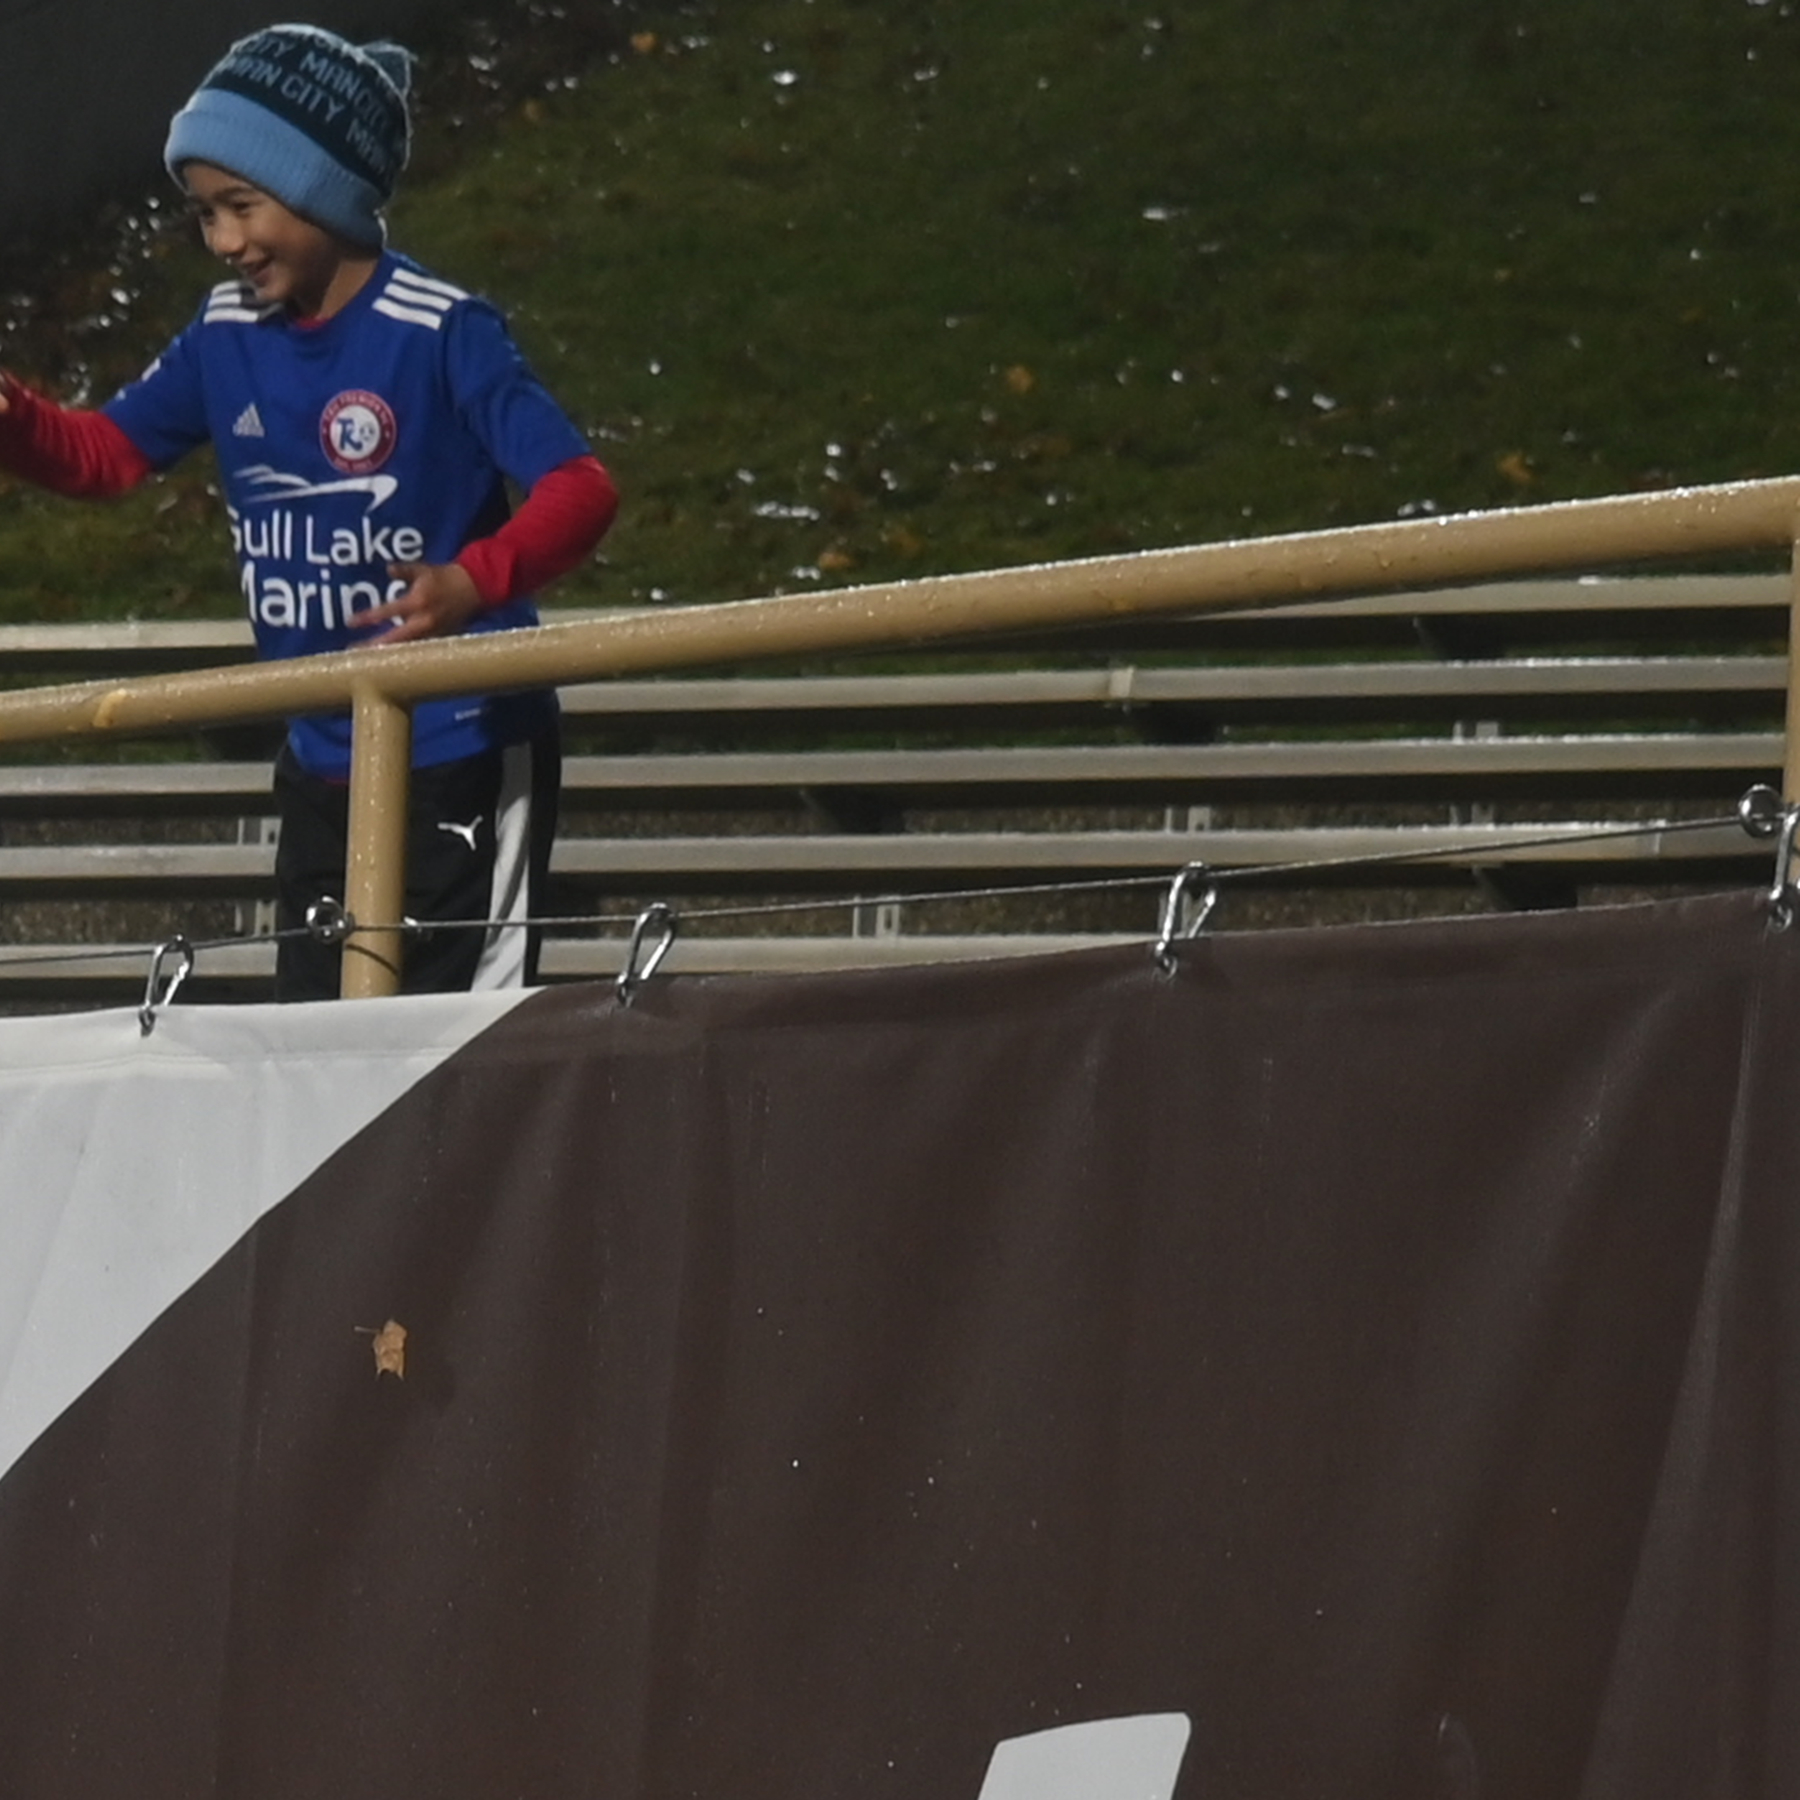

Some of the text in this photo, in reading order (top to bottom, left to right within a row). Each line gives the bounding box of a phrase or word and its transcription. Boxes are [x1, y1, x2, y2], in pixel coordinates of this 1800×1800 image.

[280, 73, 345, 123] CITY
[299, 51, 361, 100] MAN
[305, 514, 424, 567] Lake
